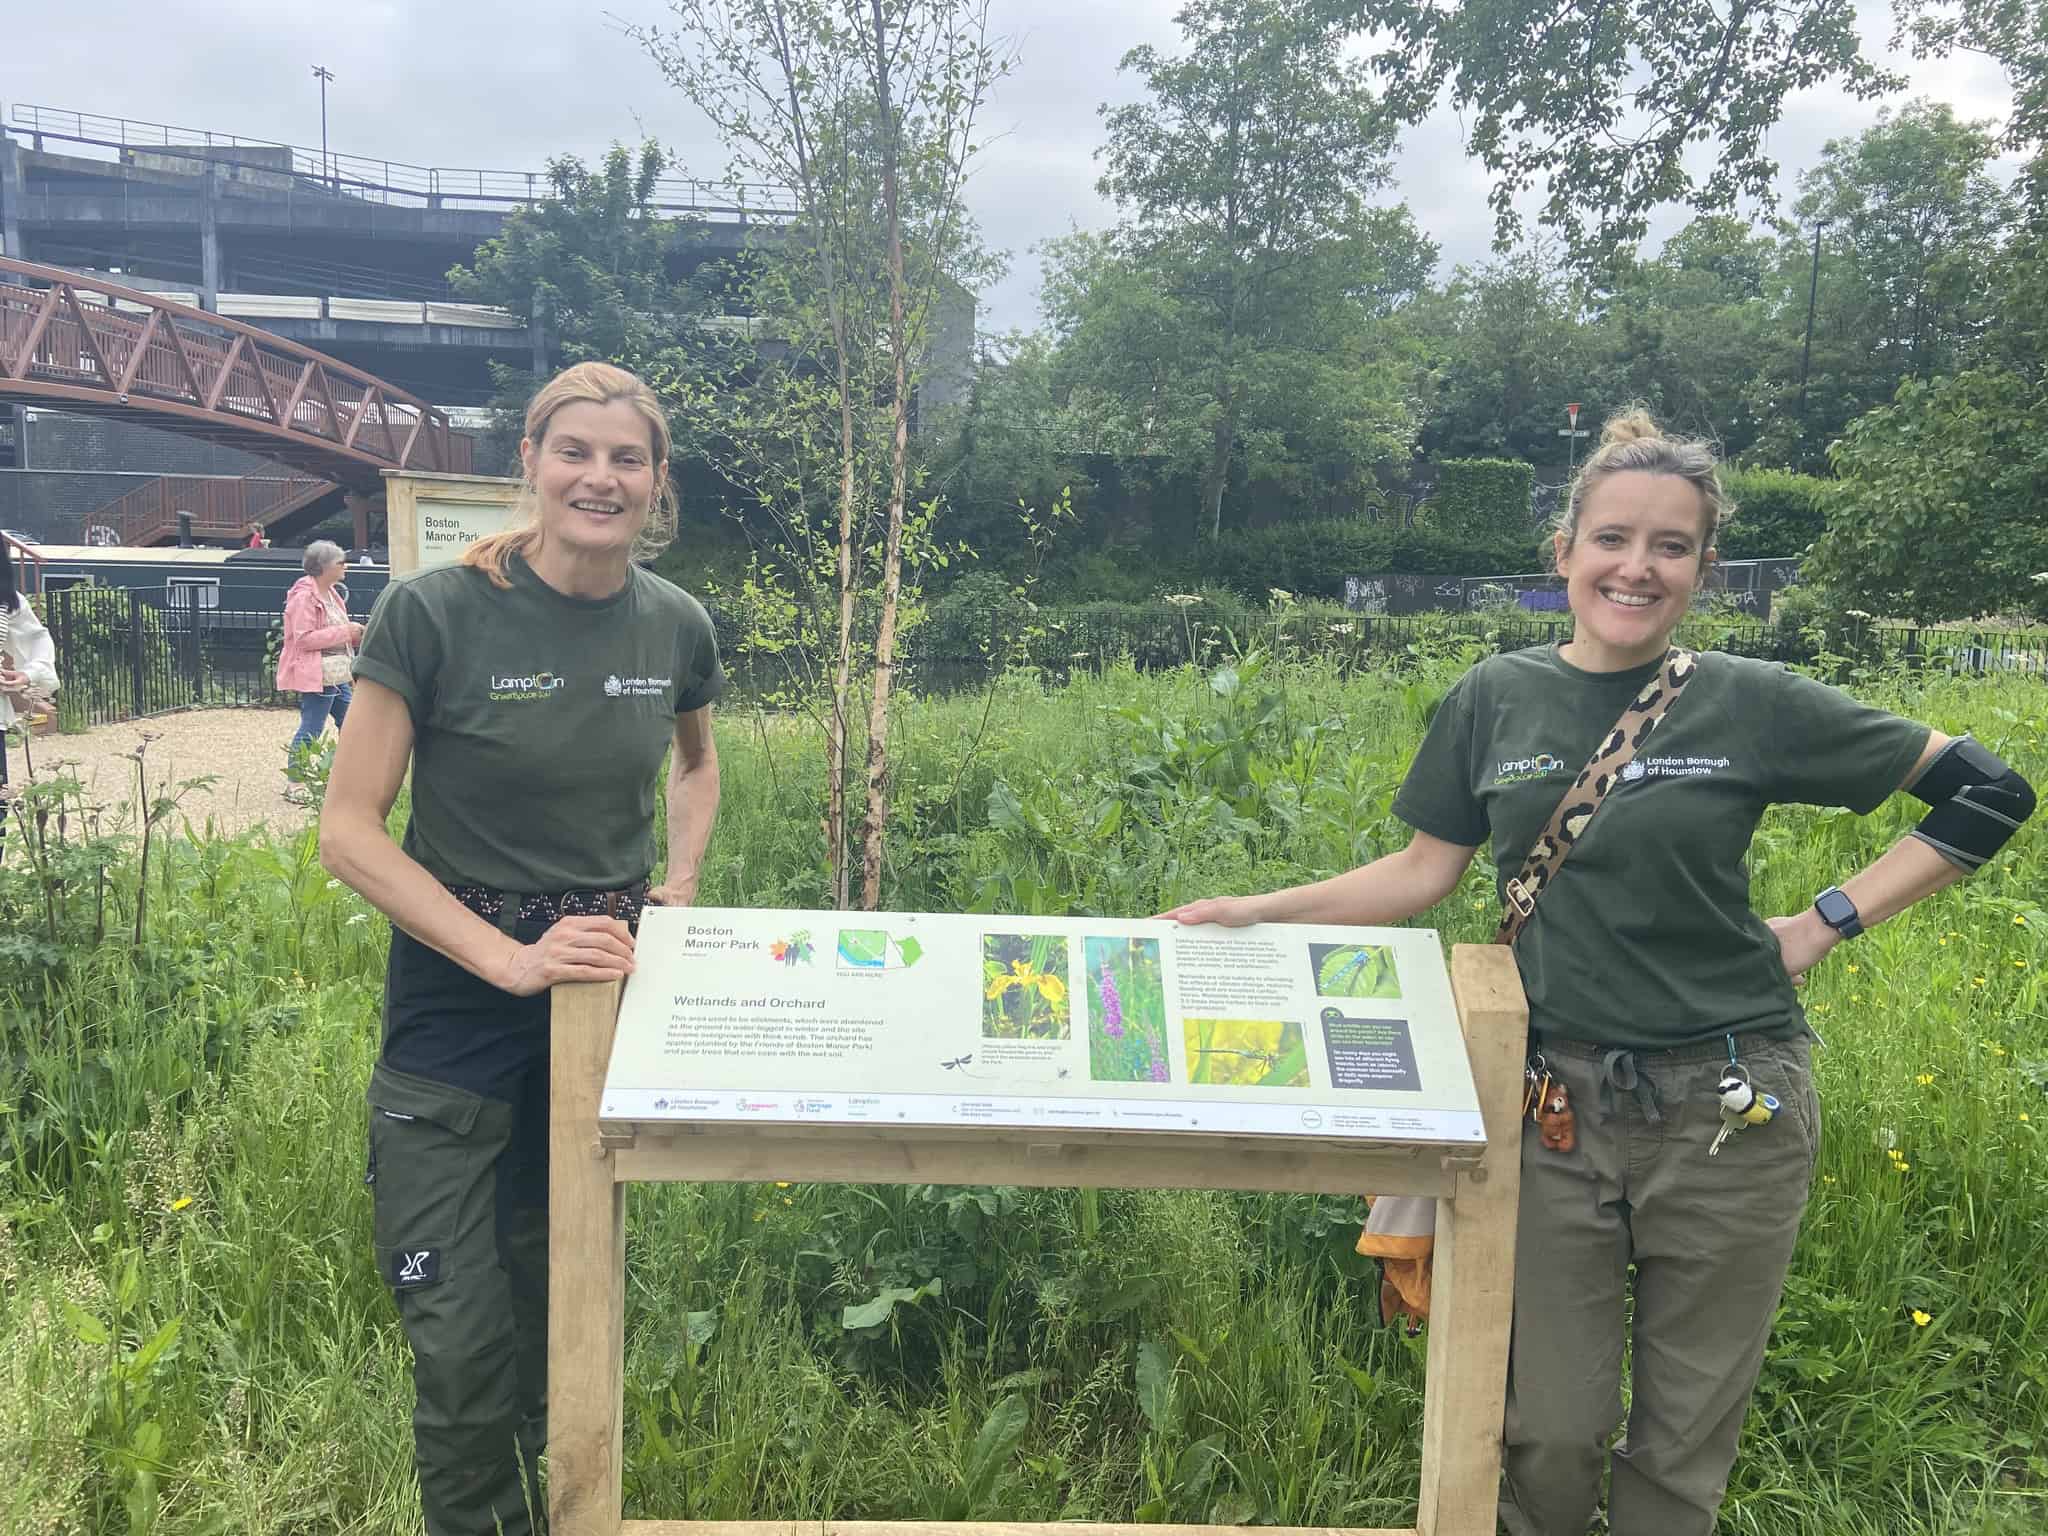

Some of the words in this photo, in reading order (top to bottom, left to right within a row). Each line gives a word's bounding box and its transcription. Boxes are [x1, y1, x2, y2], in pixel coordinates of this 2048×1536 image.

[425, 516, 460, 528] Boston
[425, 530, 457, 542] Manor
[622, 677, 647, 687] London
[622, 685, 631, 695] of
[1646, 757, 1685, 766] London
[1686, 757, 1730, 768] Borough
[1648, 766, 1660, 775] of
[1661, 766, 1712, 776] Hounslow
[687, 926, 734, 937] Boston
[684, 939, 728, 950] Manor
[729, 939, 760, 950] Park
[674, 996, 737, 1007] Wetlands
[740, 997, 766, 1008] and
[769, 998, 826, 1009] Orchard
